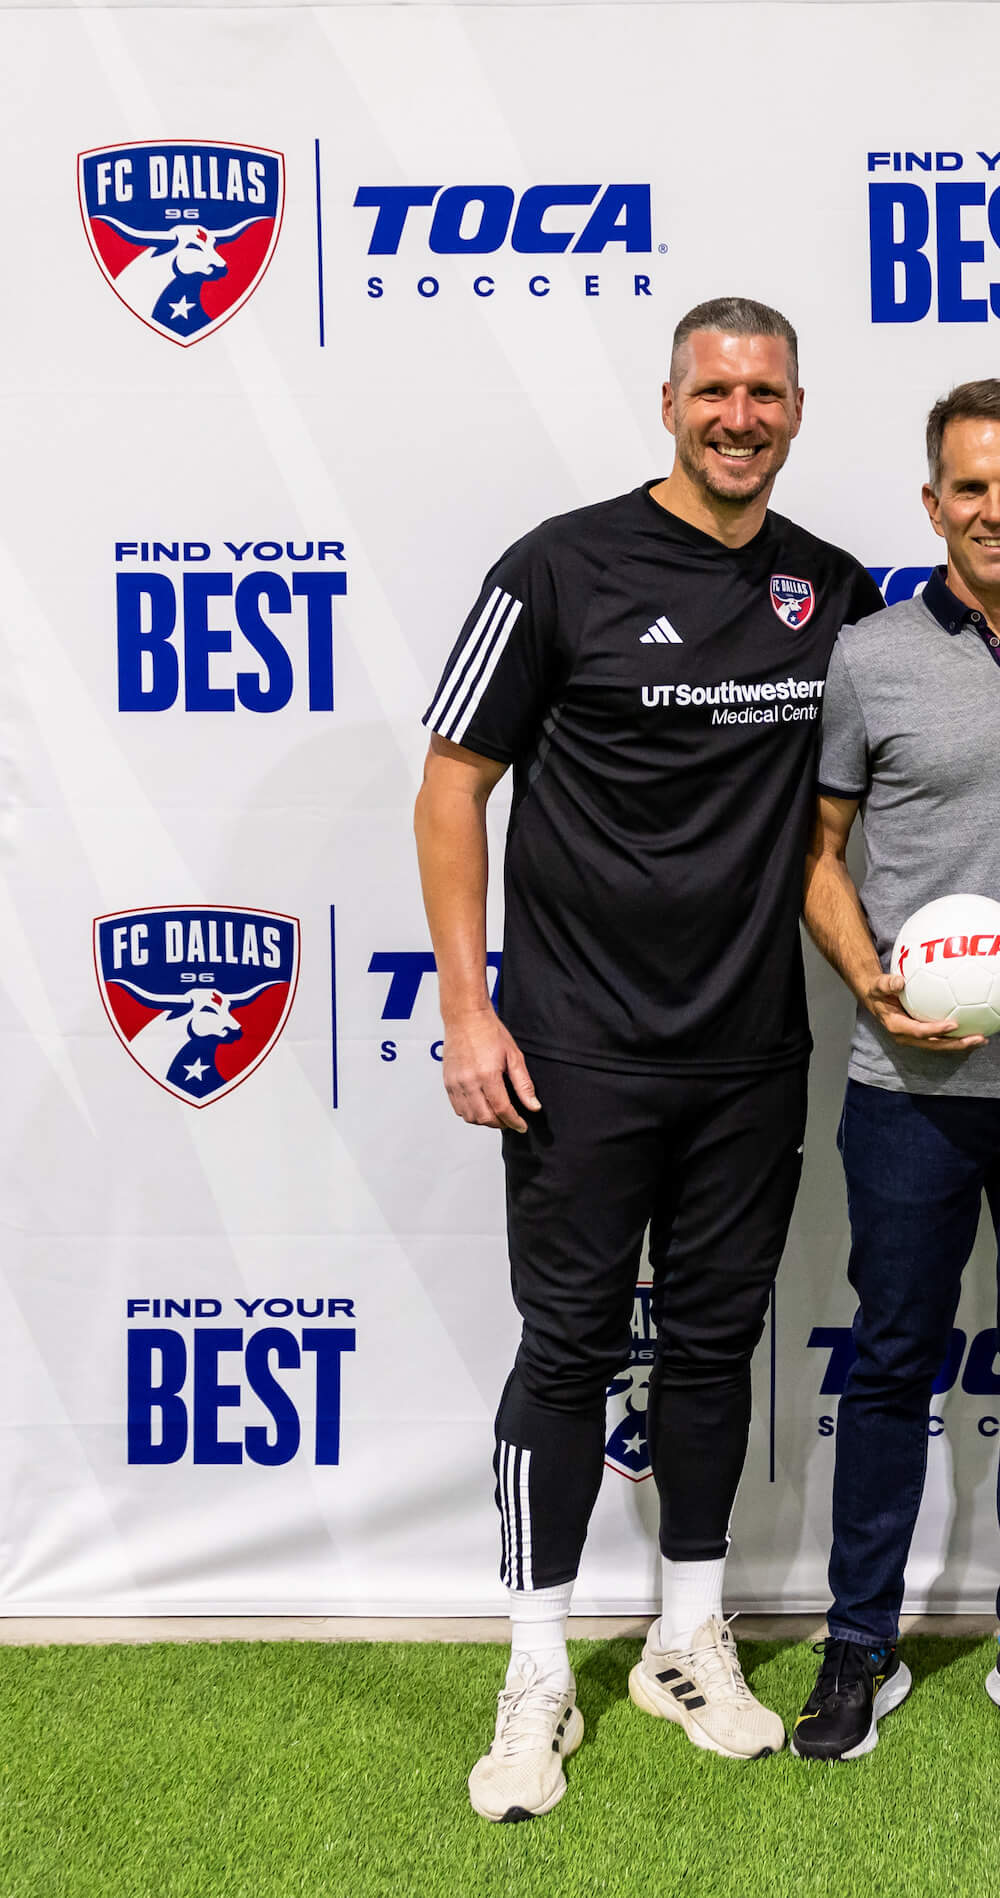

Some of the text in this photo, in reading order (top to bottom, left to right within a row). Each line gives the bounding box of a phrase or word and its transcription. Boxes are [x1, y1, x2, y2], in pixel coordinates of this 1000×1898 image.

[868, 152, 963, 171] FIND
[97, 155, 265, 205] FC DALLAS
[165, 209, 199, 218] 96
[353, 184, 652, 255] TOCA
[368, 275, 652, 298] SOCCER
[115, 542, 346, 561] FIND YOUR
[781, 580, 808, 595] DALLAS
[116, 571, 347, 713] BEST
[711, 705, 778, 725] Medical
[113, 920, 280, 969] FC DALLAS
[181, 973, 214, 982] 96
[128, 1299, 355, 1318] FIND YOUR
[128, 1327, 356, 1466] BEST
